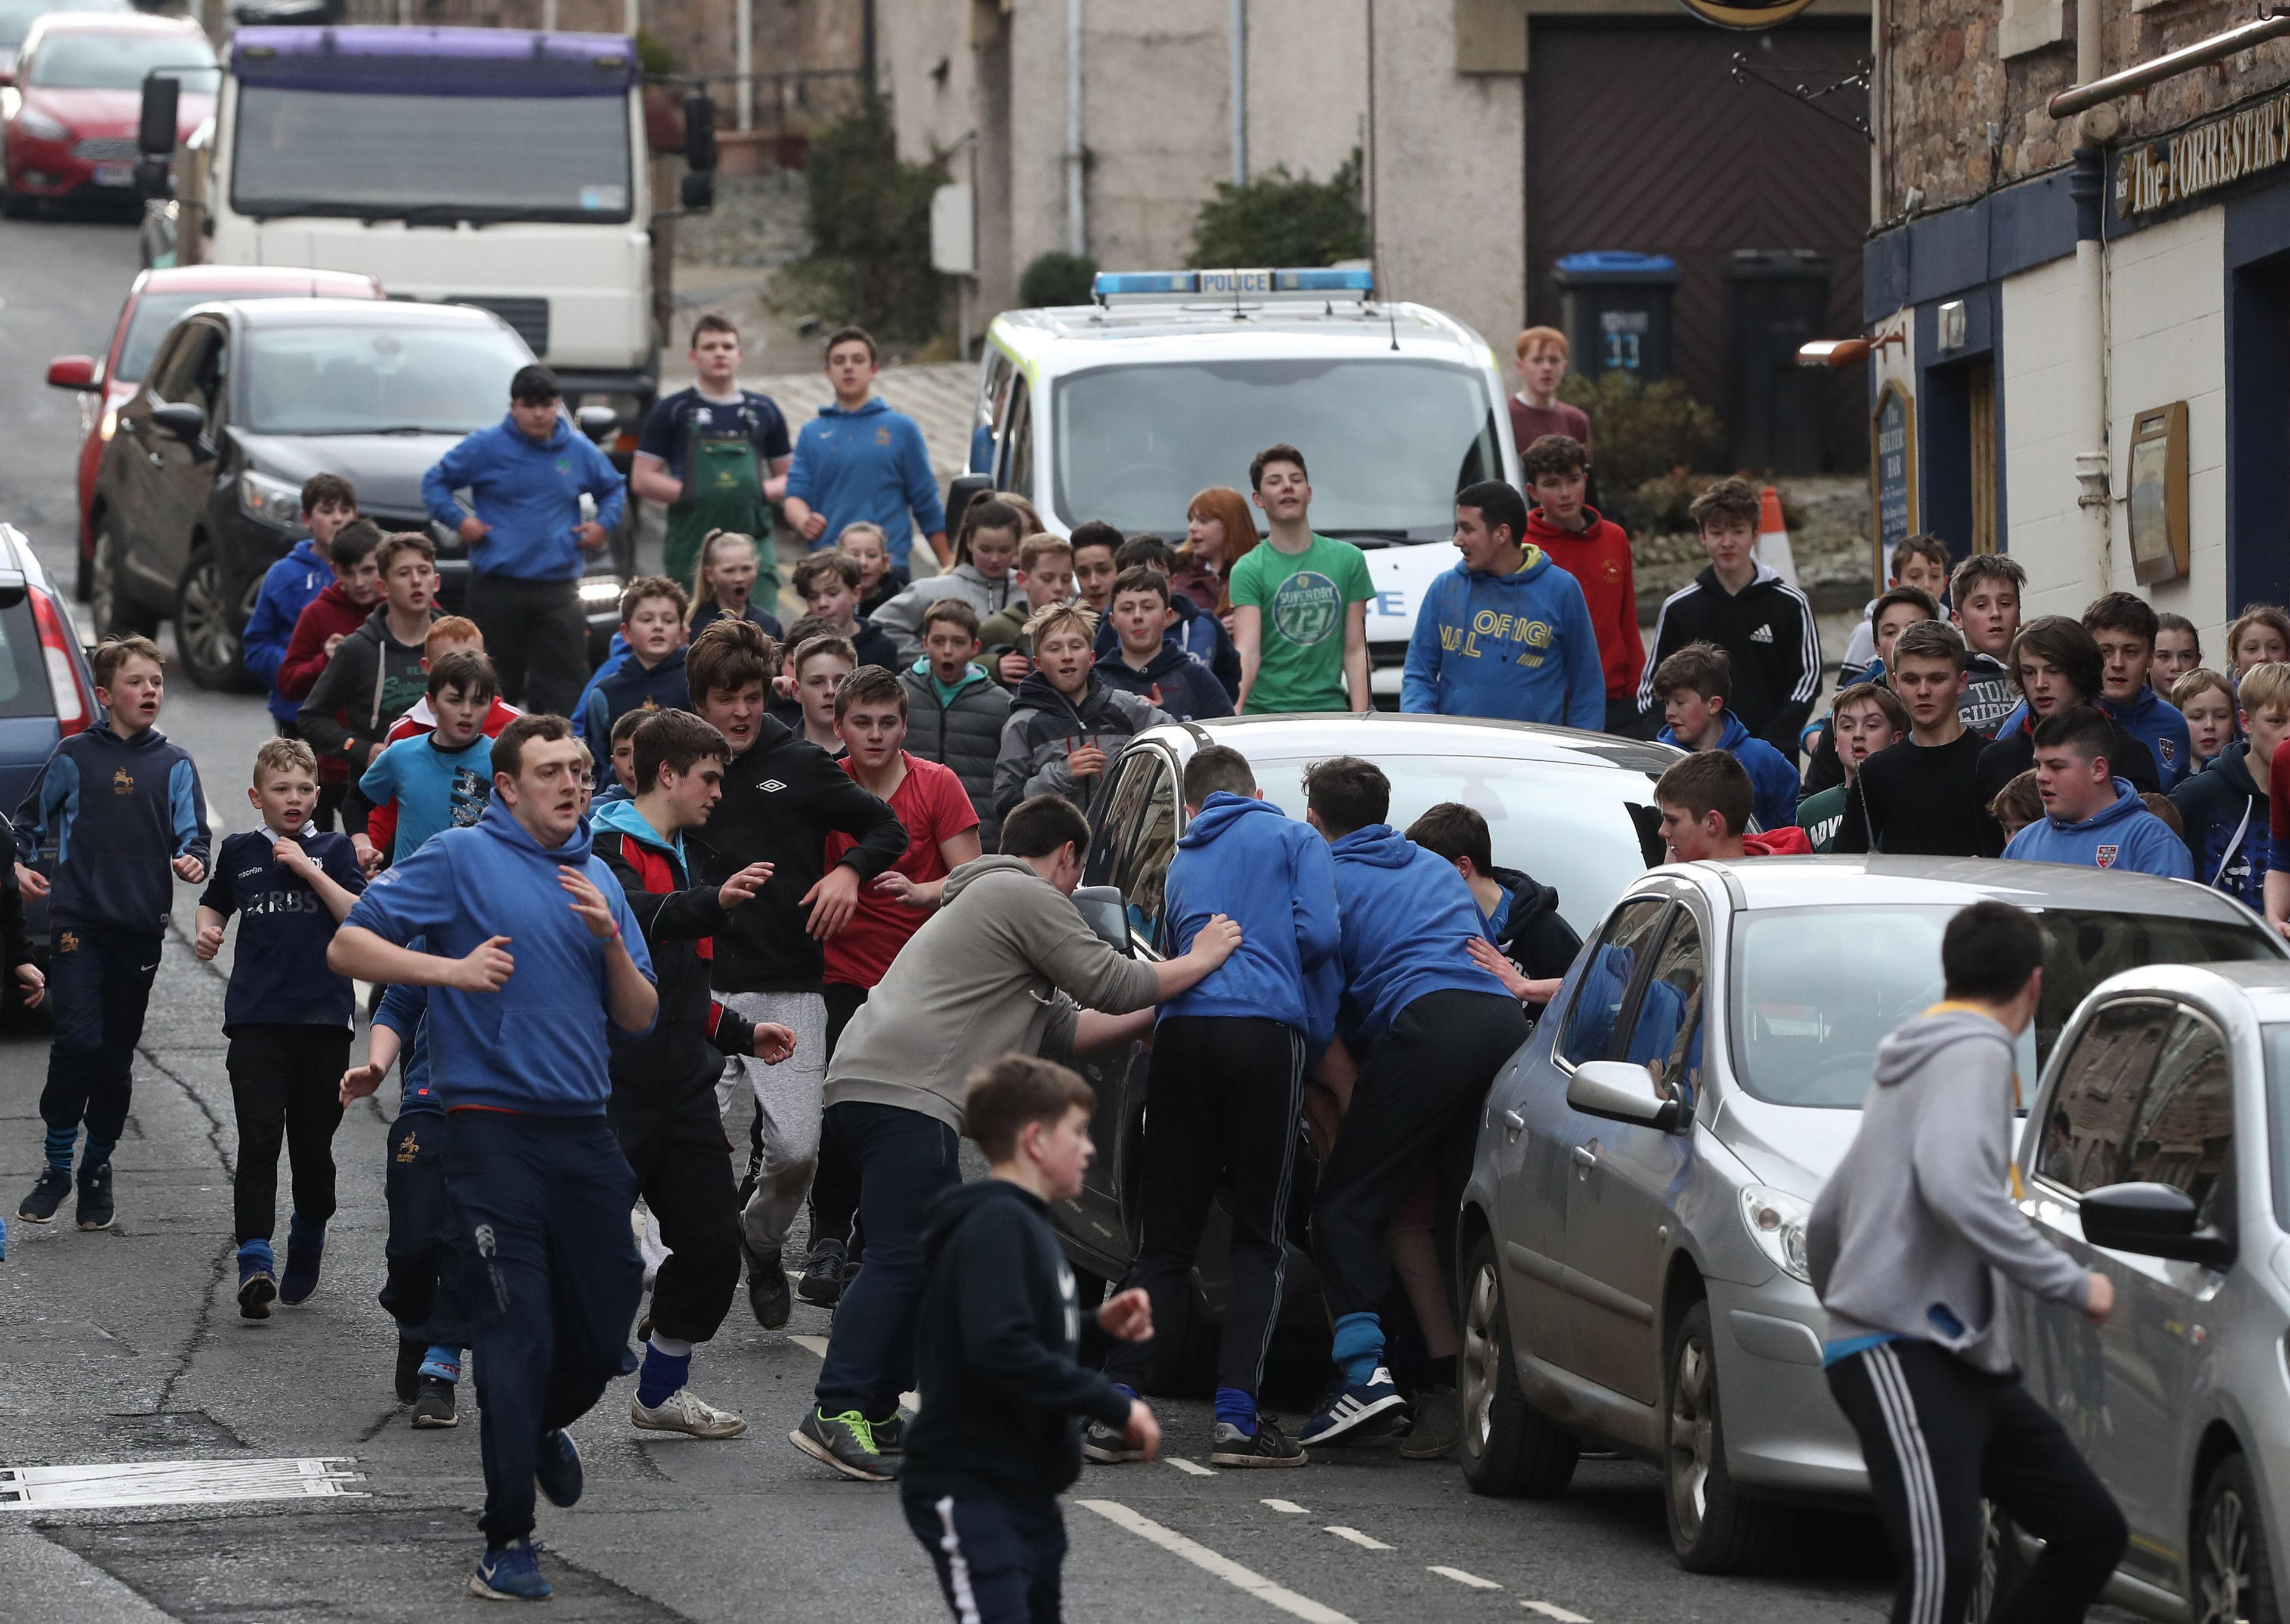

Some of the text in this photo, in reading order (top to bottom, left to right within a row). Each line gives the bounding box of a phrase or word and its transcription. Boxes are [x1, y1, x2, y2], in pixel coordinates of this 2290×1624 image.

[2133, 94, 2289, 213] The FORRESTER'S
[1203, 274, 1266, 291] POLICE
[1887, 455, 1901, 478] BAR
[1280, 586, 1334, 605] SUPERDRY
[1279, 599, 1336, 634] 727
[1749, 634, 1774, 644] adidas
[269, 890, 318, 913] RBS
